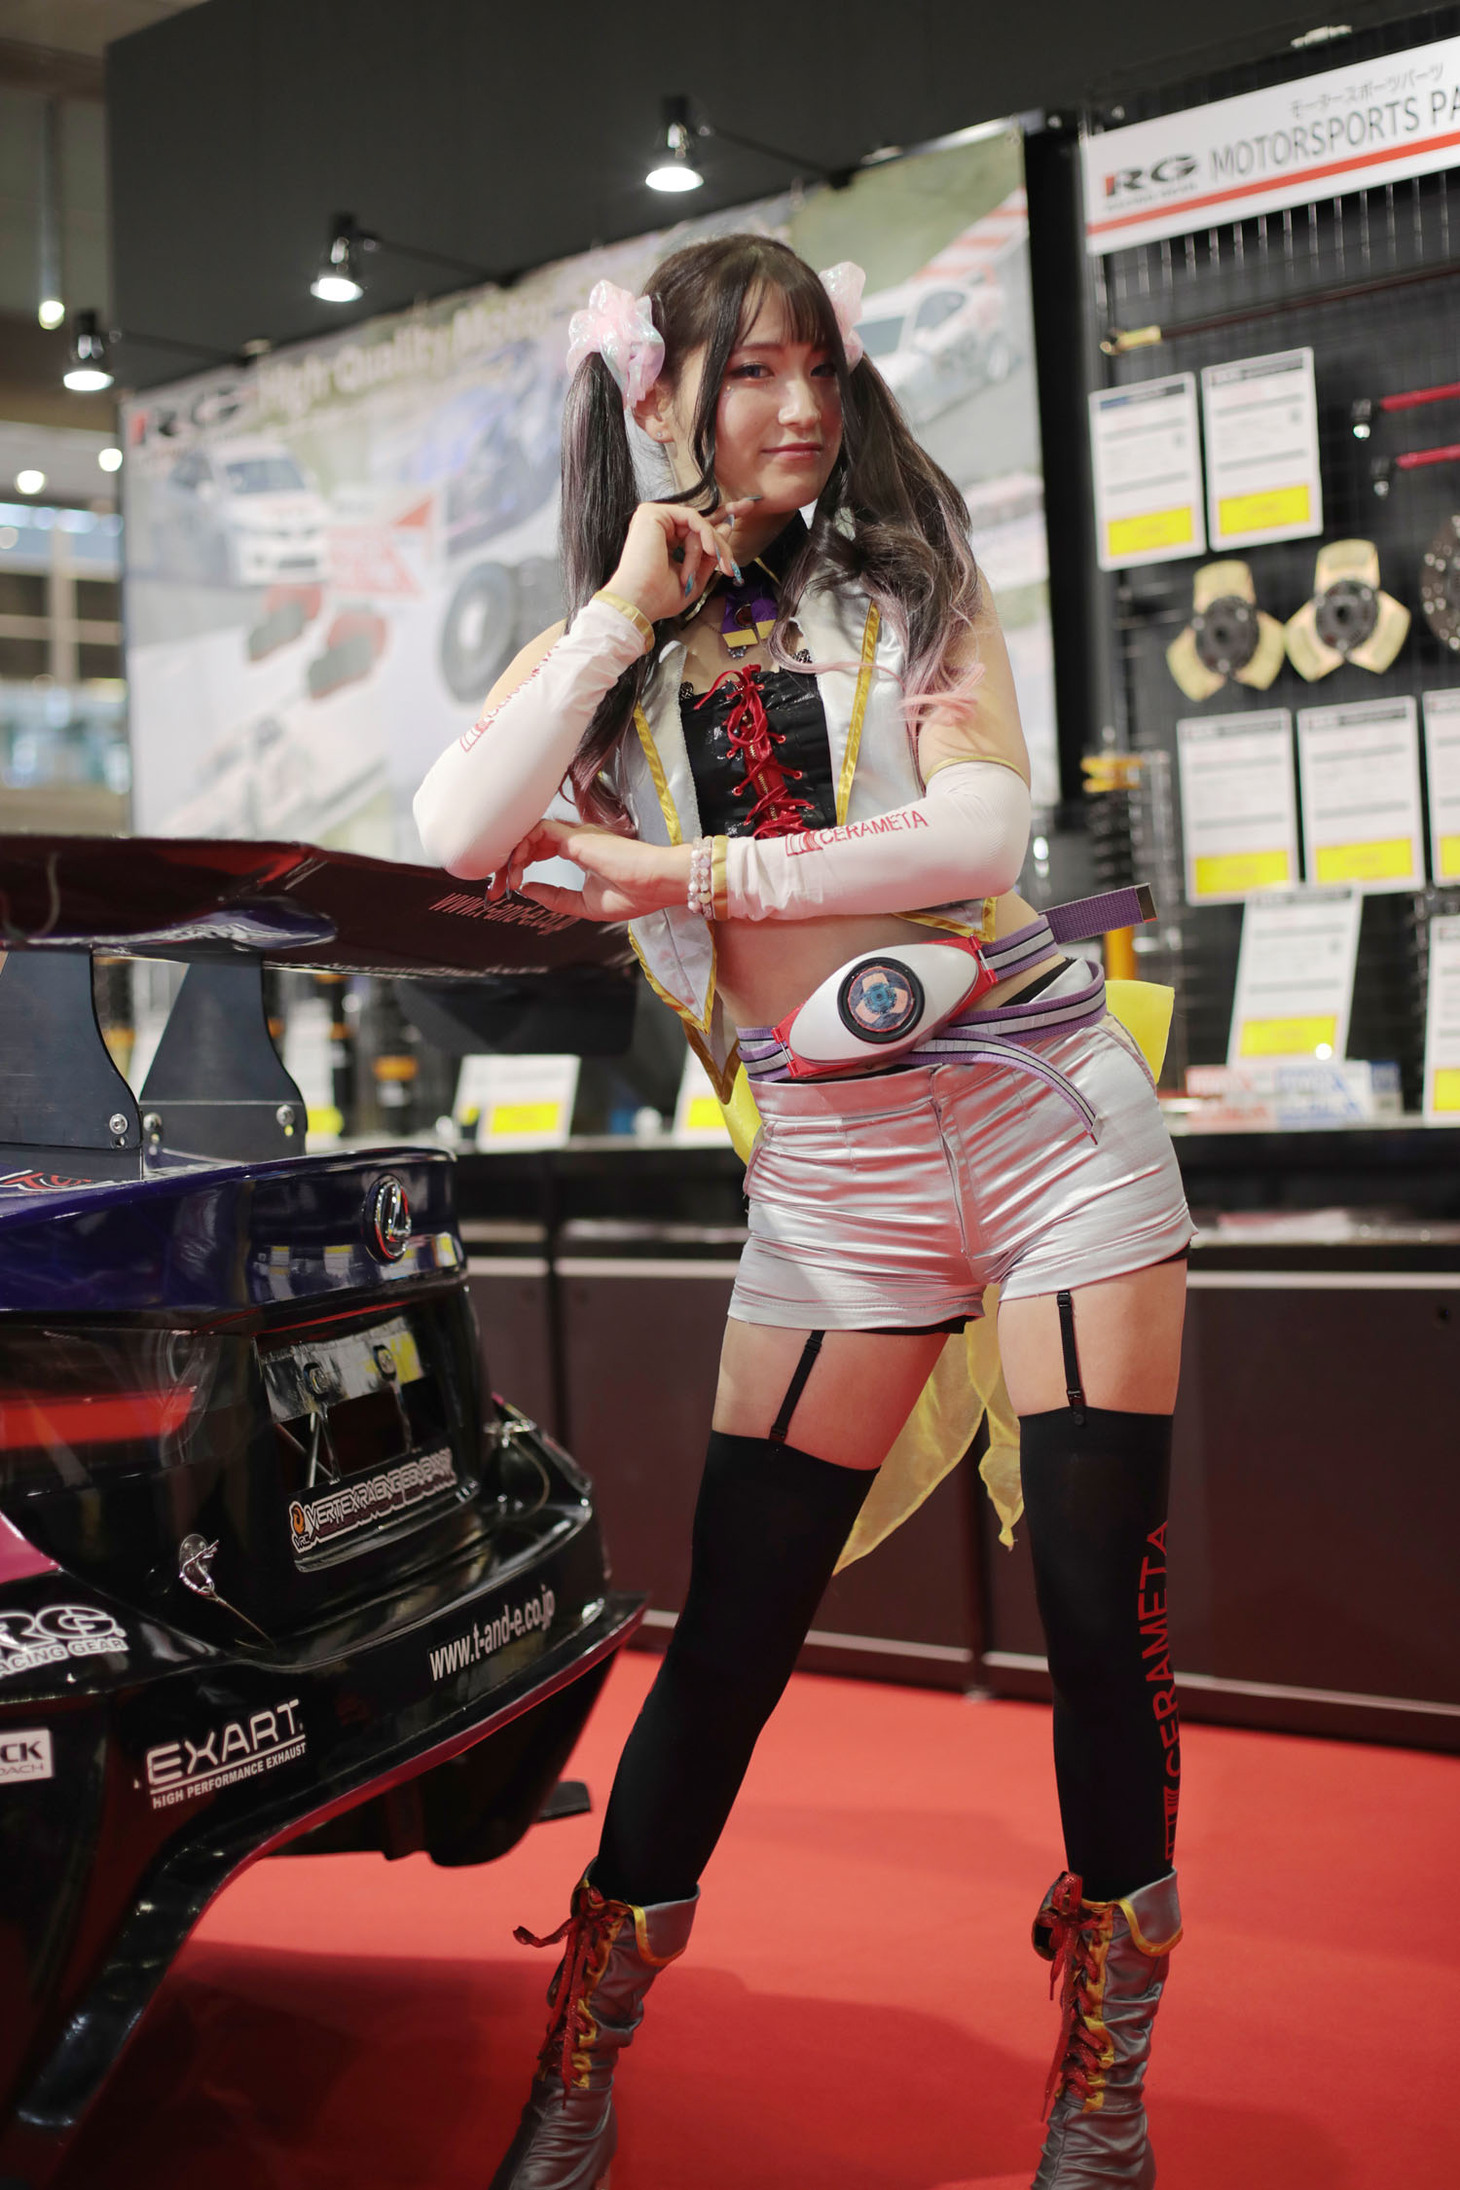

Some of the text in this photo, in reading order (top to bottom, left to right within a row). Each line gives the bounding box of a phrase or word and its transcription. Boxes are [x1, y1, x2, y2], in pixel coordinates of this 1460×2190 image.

[1209, 95, 1421, 182] MOTORSPORTS
[820, 810, 929, 845] CERAMETA
[70, 1638, 126, 1655] GEAR
[430, 1584, 556, 1681] www.t-and-e.co.jp
[1138, 1521, 1181, 1776] CERAMETA
[147, 1699, 299, 1785] EXART
[153, 1742, 307, 1810] HIGH PERFORMANCE EXHAUST
